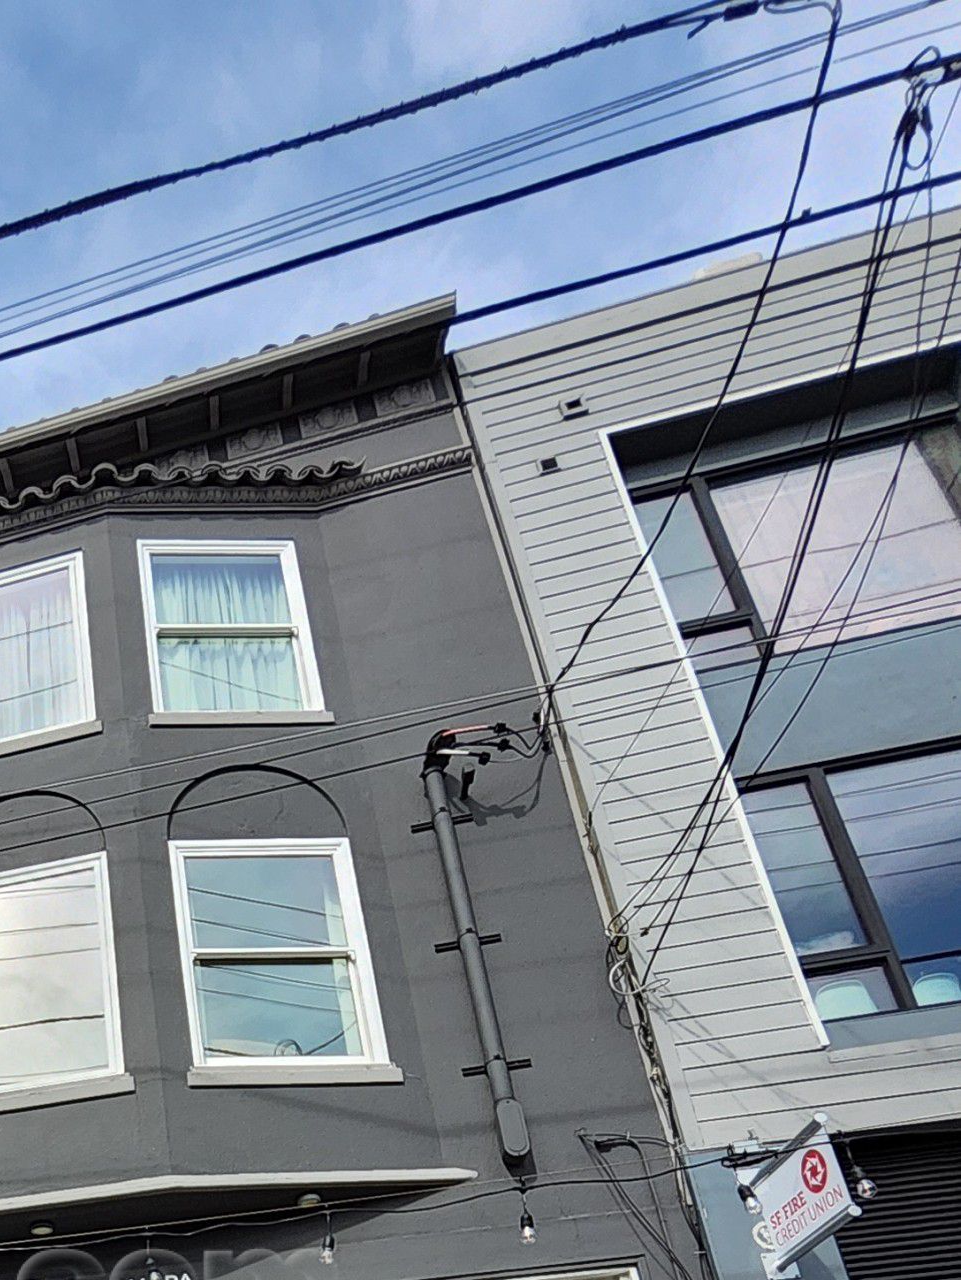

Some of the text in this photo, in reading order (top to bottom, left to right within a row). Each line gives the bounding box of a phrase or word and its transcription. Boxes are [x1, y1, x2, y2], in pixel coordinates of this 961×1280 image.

[769, 1191, 807, 1229] SF FIRE
[775, 1184, 843, 1247] CREDIT UNION
